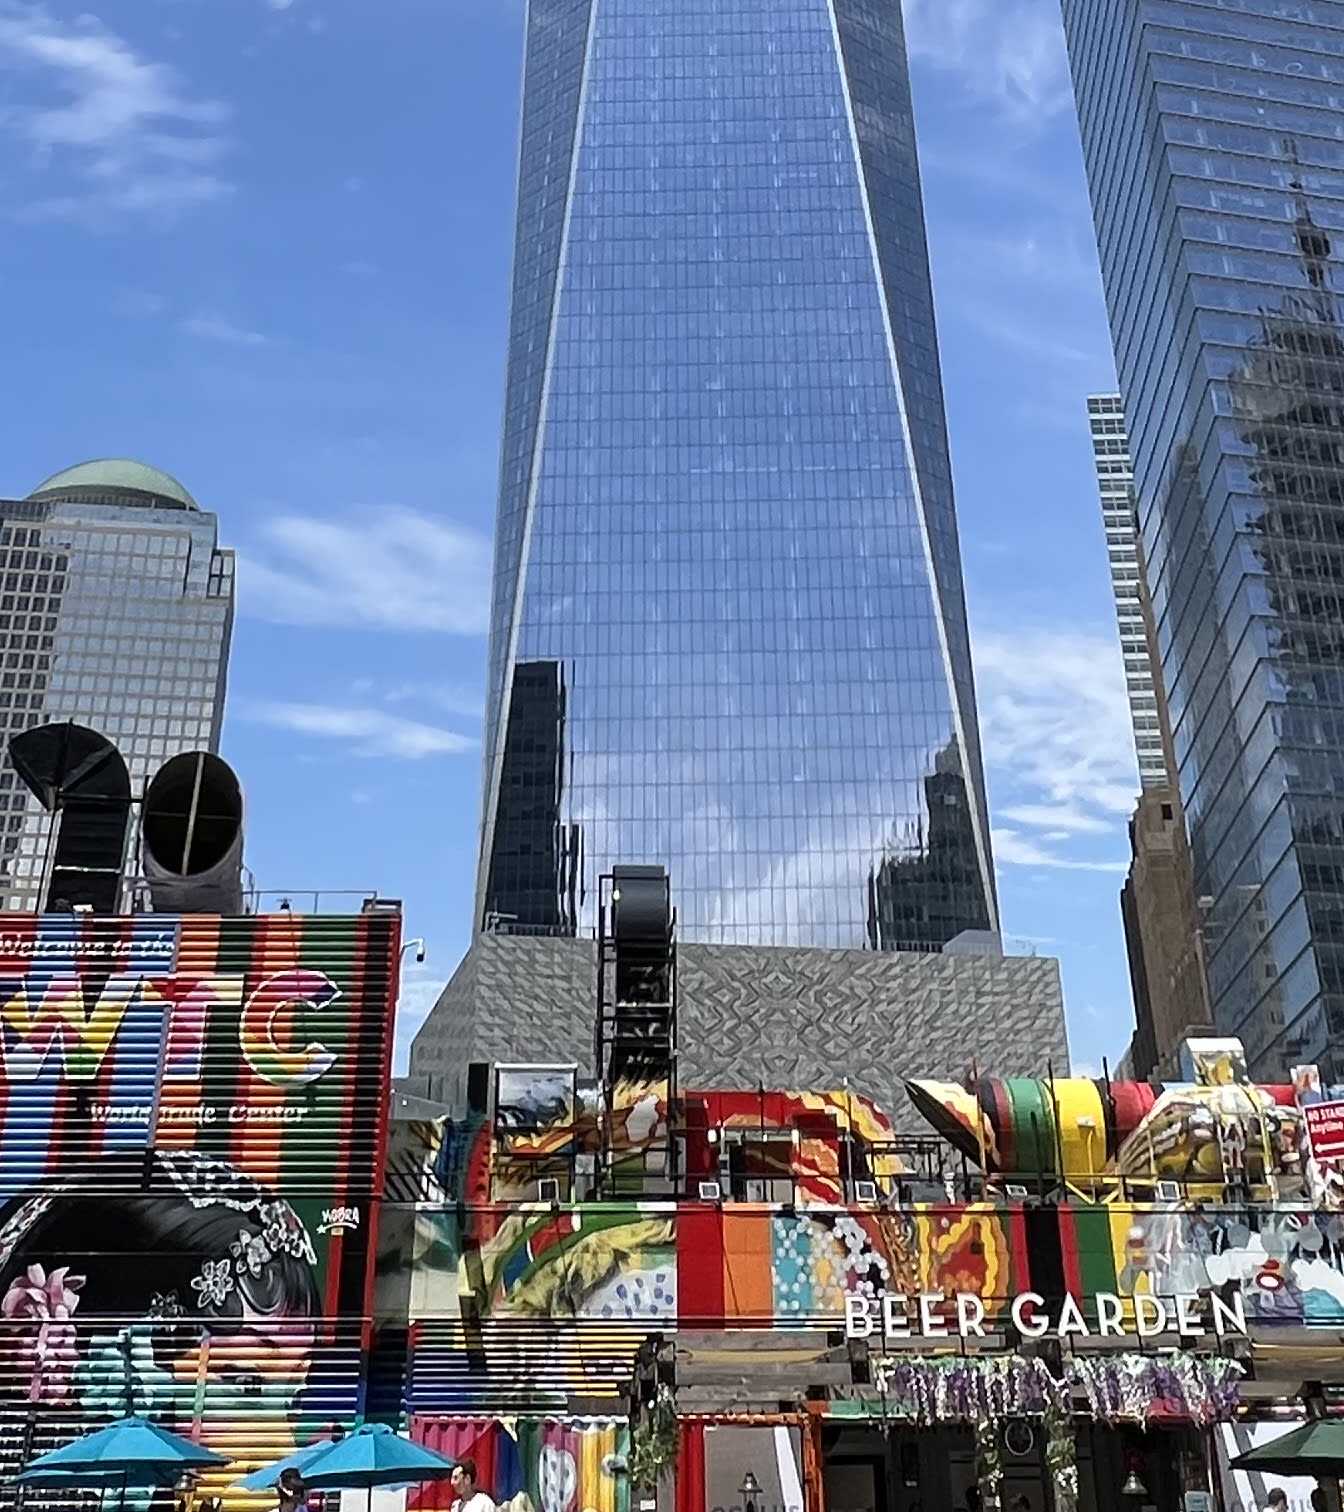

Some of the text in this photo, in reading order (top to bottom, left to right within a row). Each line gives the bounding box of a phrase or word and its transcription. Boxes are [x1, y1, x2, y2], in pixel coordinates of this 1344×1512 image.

[110, 938, 132, 956] to
[139, 933, 175, 956] the
[90, 1102, 152, 1125] World
[228, 1104, 309, 1123] Center
[1307, 1108, 1320, 1122] NO
[1310, 1120, 1344, 1135] Anytime
[845, 1290, 1249, 1339] BEER GARDEN
